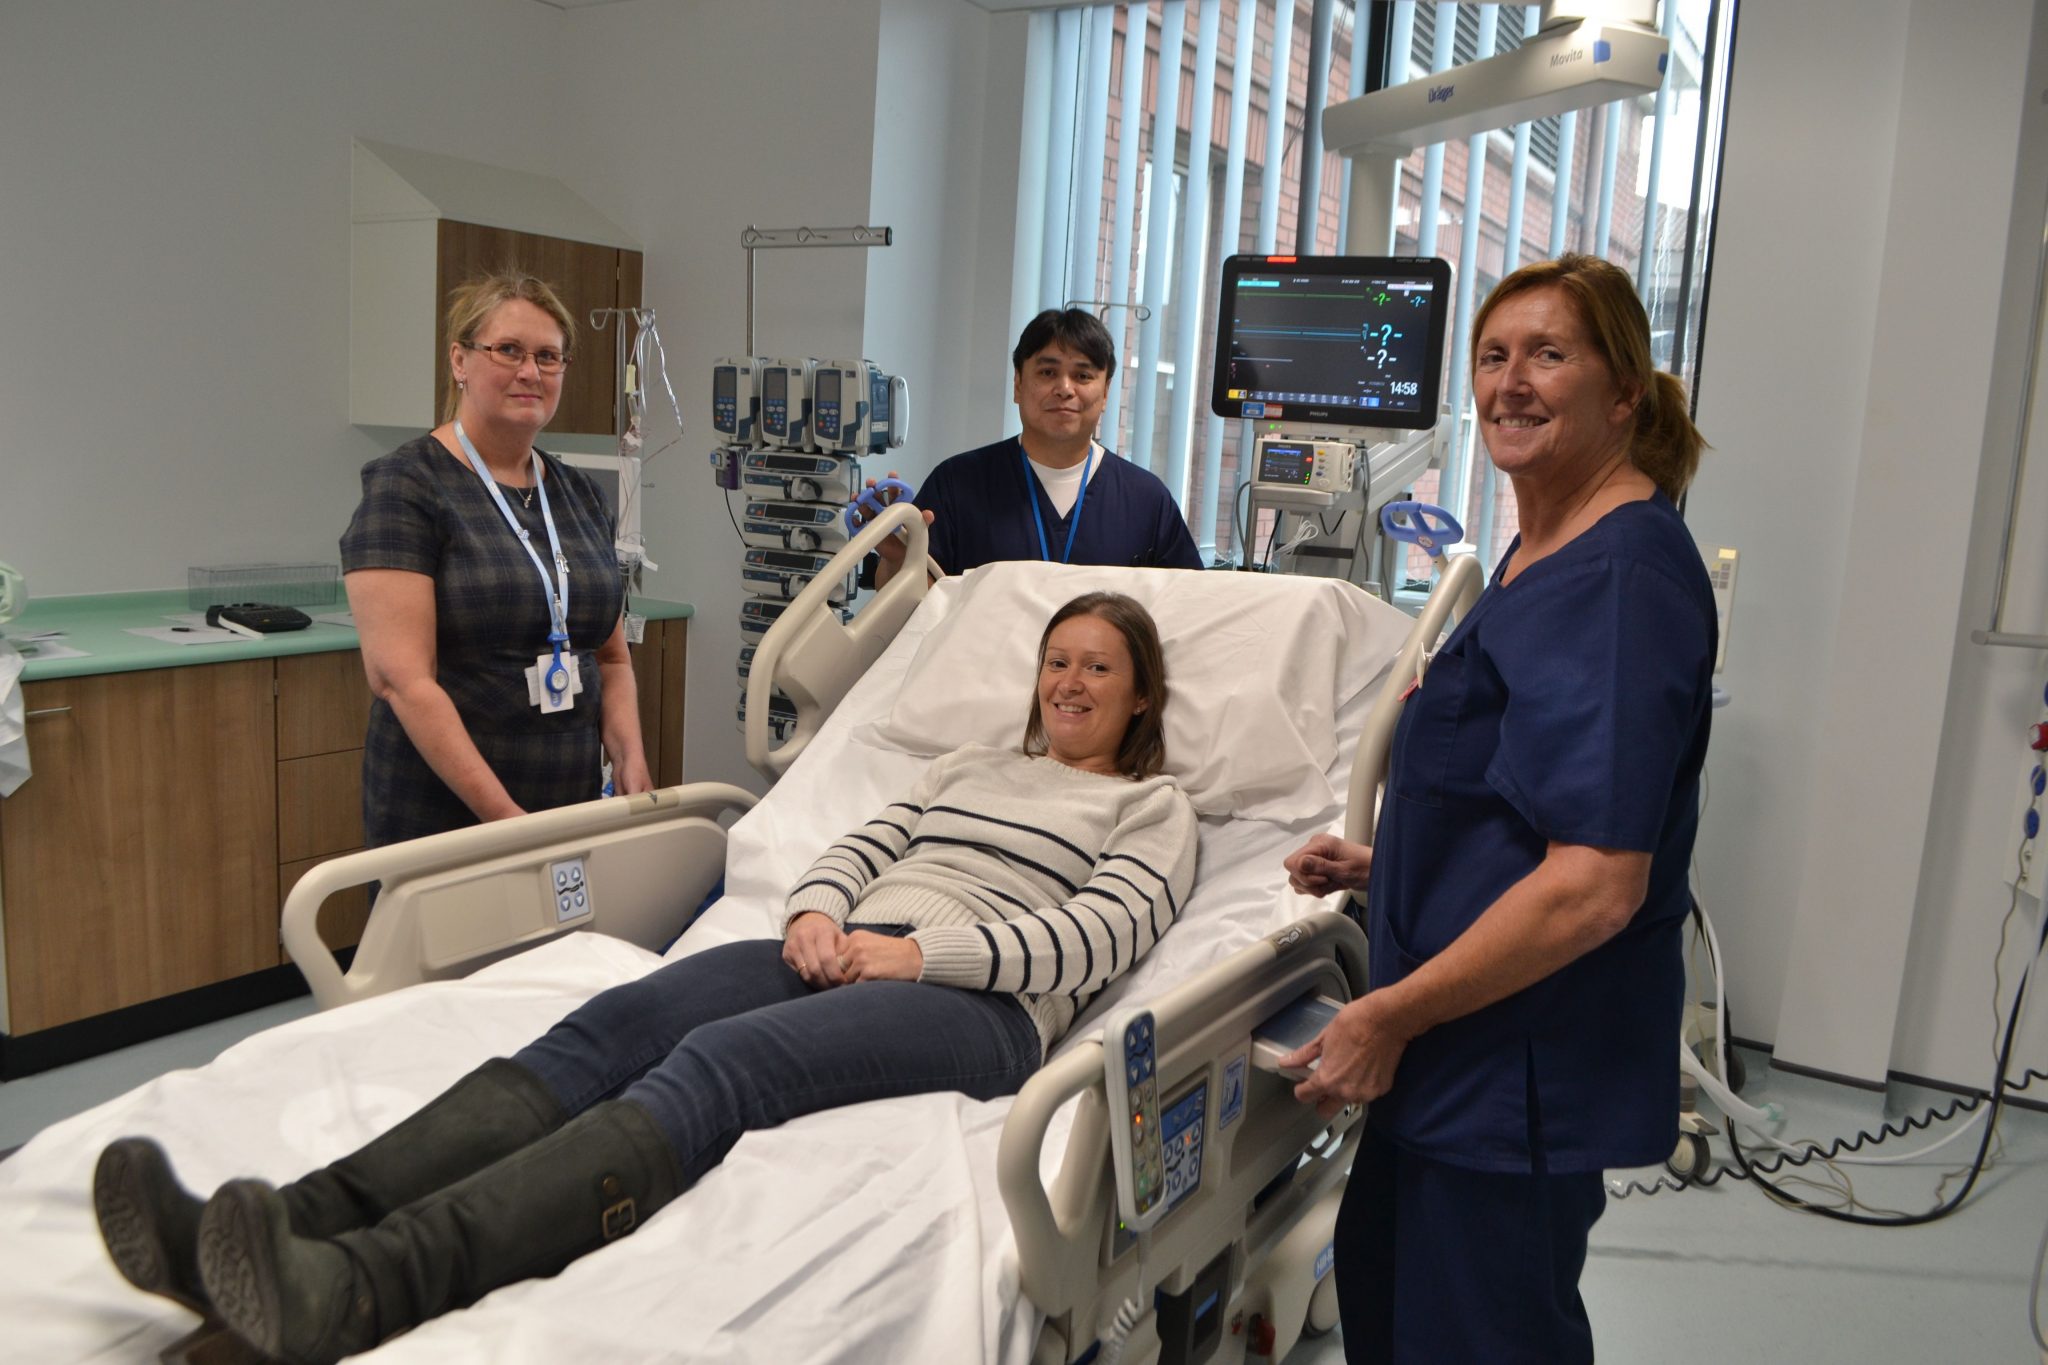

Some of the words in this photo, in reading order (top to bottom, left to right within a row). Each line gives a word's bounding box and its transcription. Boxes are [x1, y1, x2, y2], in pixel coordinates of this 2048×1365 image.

[1550, 48, 1583, 68] Movita
[1390, 381, 1418, 396] 14:58
[1315, 1246, 1334, 1276] Hill-R
